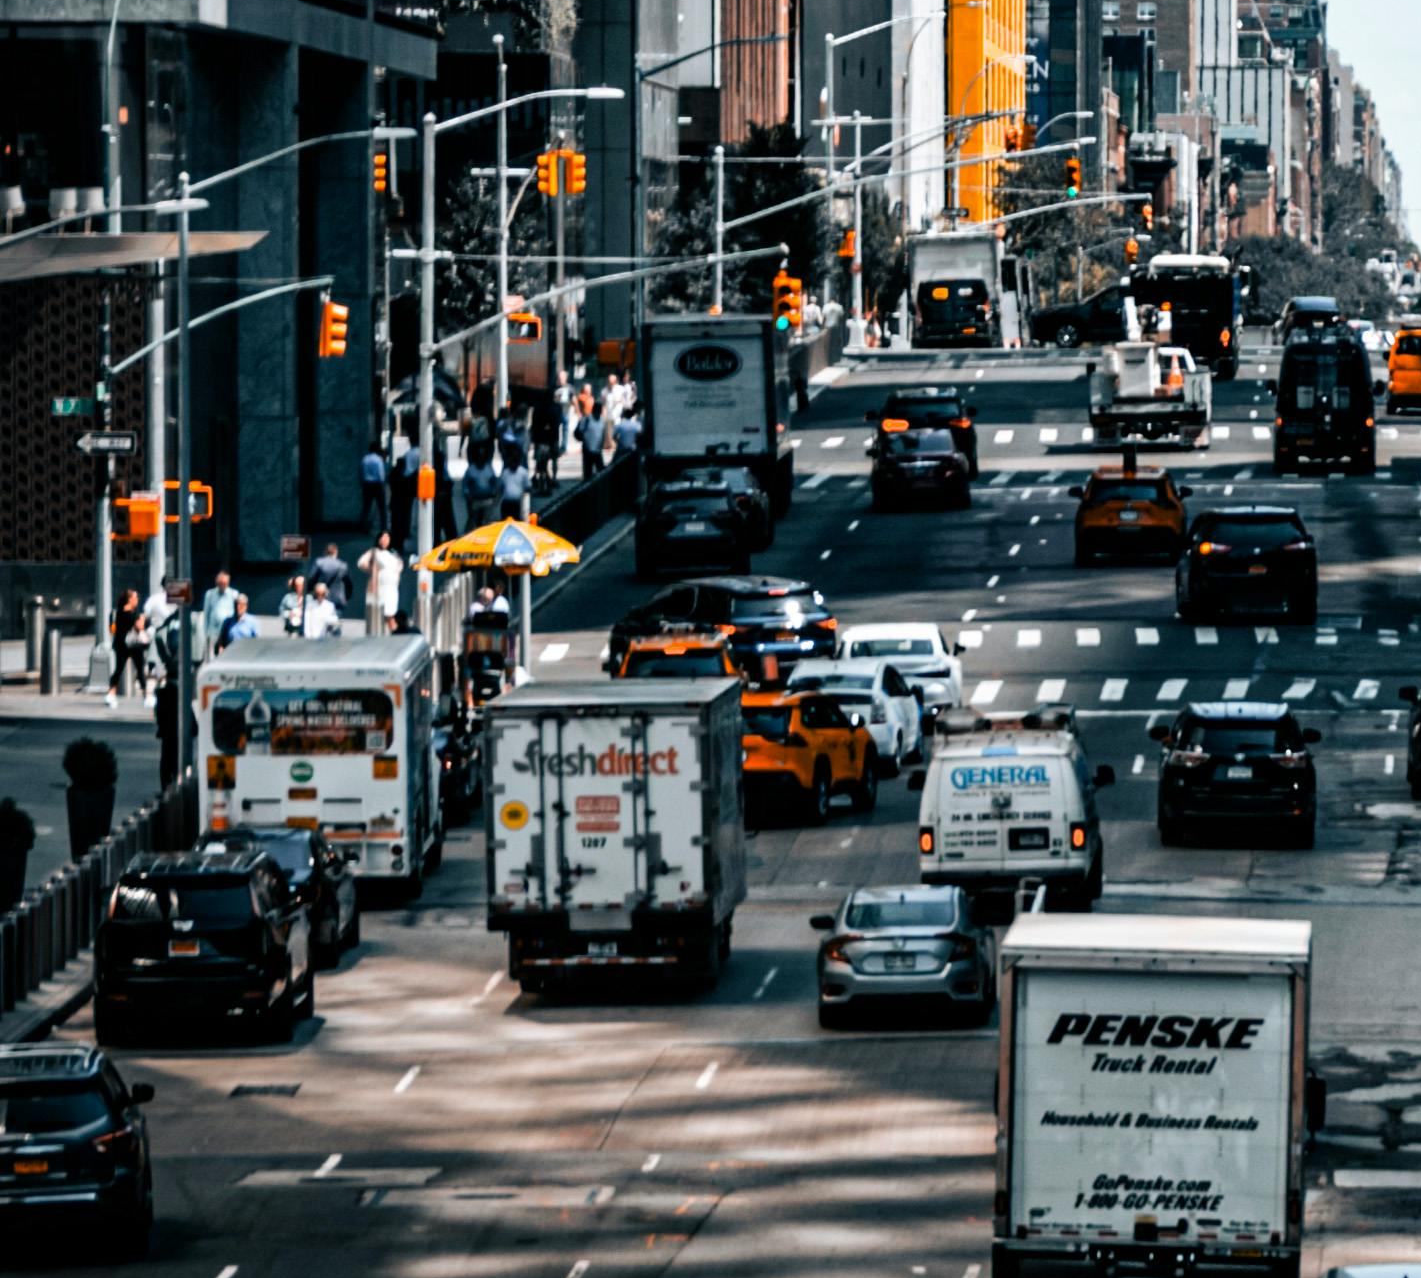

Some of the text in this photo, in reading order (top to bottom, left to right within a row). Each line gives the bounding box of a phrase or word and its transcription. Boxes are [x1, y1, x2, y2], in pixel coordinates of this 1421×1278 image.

[524, 739, 680, 777] freshdirect
[951, 765, 1050, 790] GENERAL
[1046, 1013, 1264, 1050] PENSKE
[1091, 1053, 1218, 1076] Truck Rental
[1040, 1110, 1260, 1132] Household & Business Rentals
[1092, 1174, 1212, 1193] GoPenske.com
[1074, 1192, 1224, 1212] 1-800-GO-PENSKE
